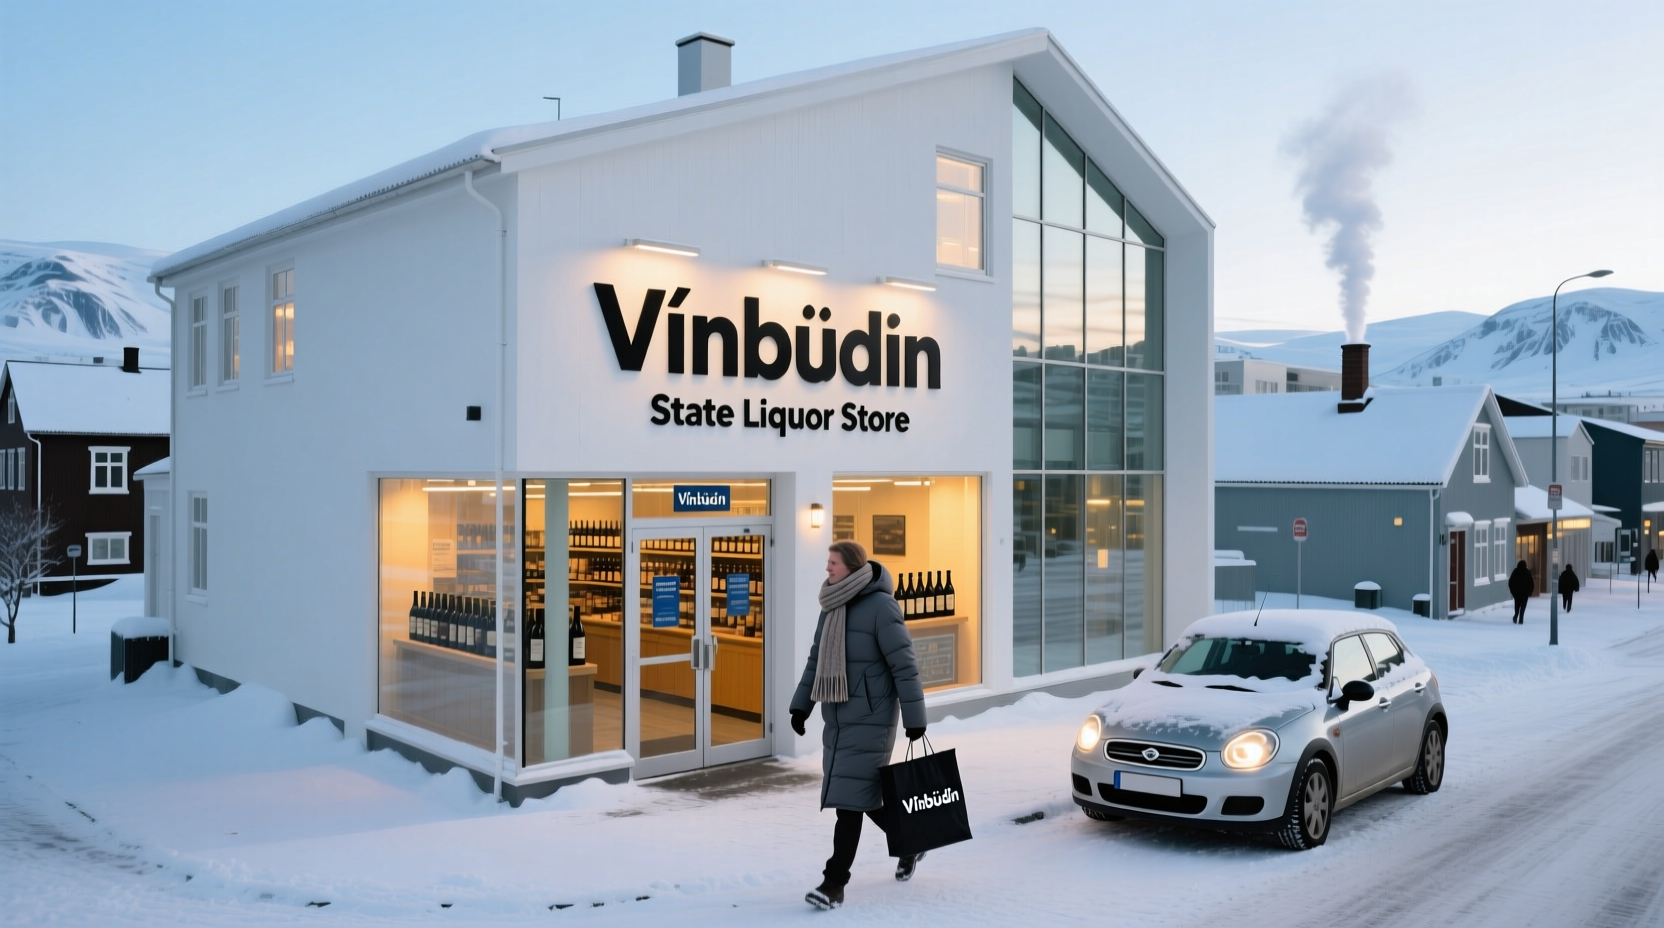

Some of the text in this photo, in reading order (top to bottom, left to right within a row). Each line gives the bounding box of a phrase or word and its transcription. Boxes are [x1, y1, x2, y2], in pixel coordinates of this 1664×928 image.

[593, 282, 942, 390] Vínbüdin
[650, 393, 910, 438] State Liquor Store
